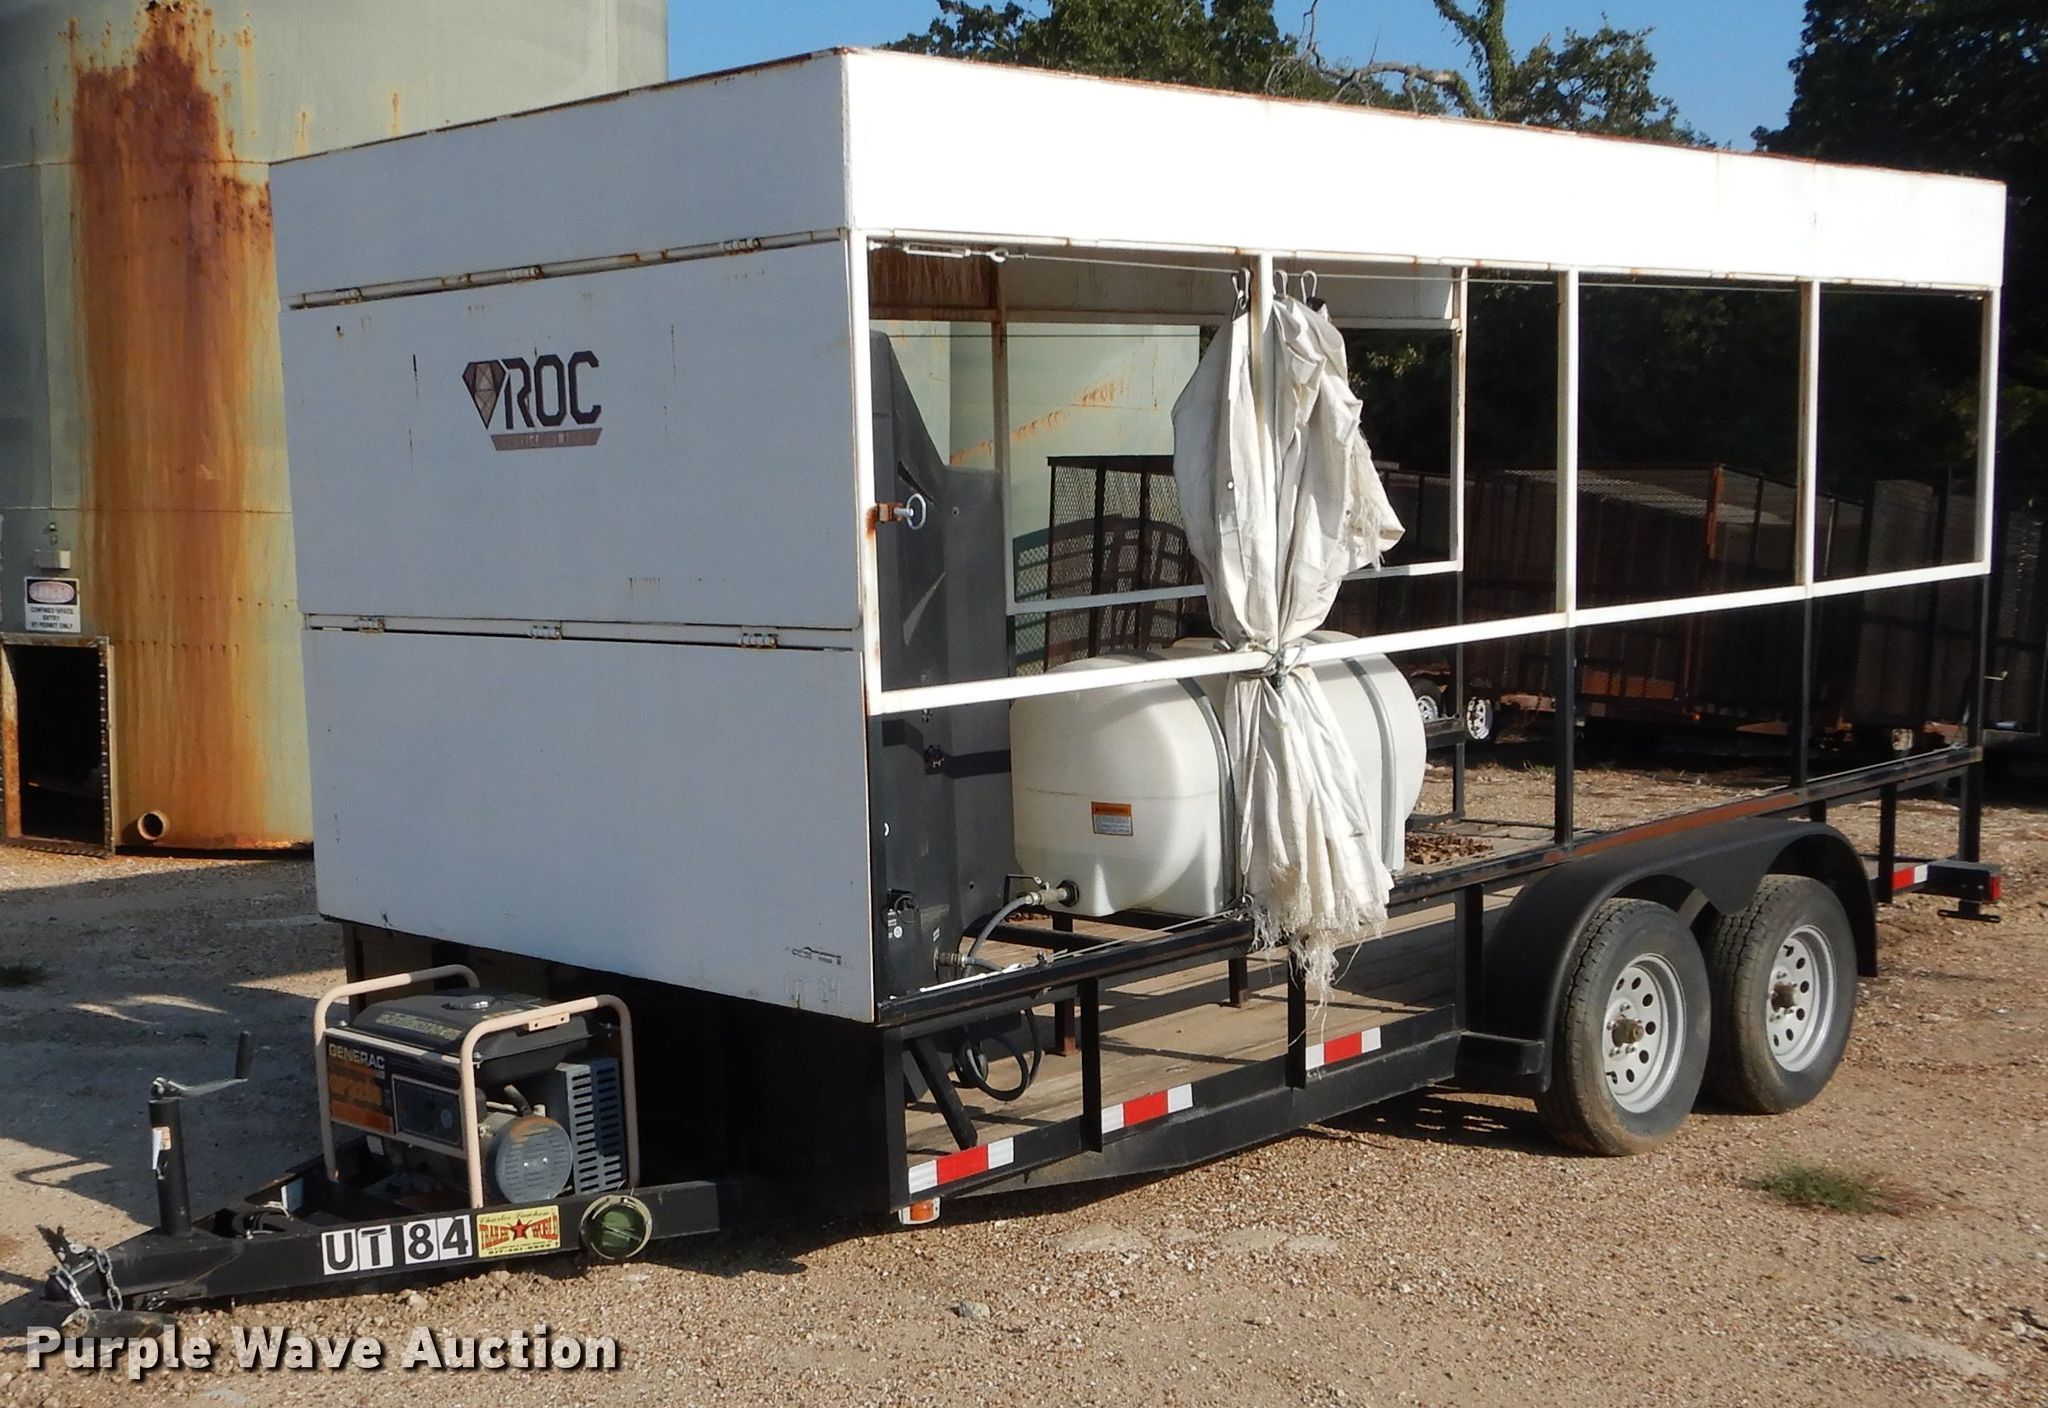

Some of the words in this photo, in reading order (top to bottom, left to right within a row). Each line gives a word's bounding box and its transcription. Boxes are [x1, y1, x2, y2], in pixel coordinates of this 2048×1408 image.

[502, 351, 602, 430] ROC
[328, 1043, 386, 1071] GENERAC
[325, 1228, 388, 1271] UT
[408, 1218, 469, 1260] 84
